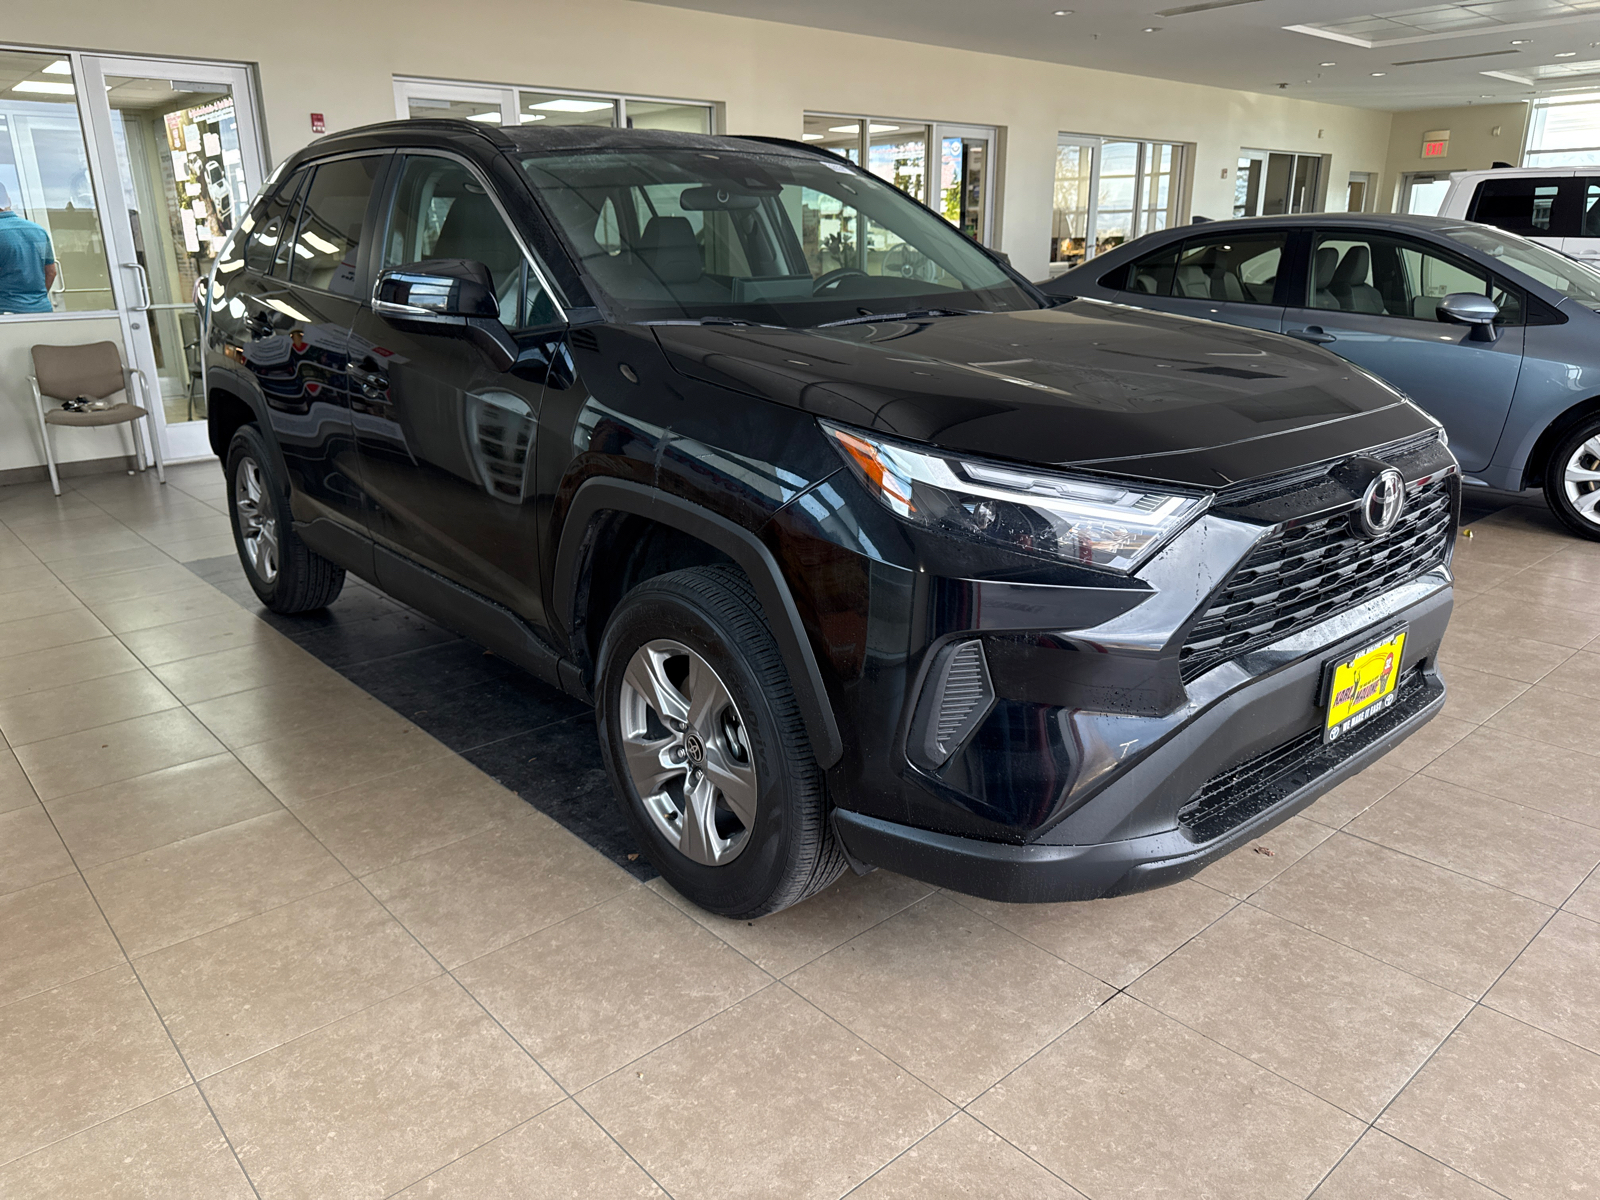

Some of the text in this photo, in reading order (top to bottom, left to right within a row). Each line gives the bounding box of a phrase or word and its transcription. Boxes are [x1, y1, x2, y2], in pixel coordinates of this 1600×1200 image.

[1426, 142, 1444, 156] EXIT
[1342, 720, 1351, 732] WE
[1351, 711, 1365, 727] MAKE
[1370, 700, 1382, 715] EASY
